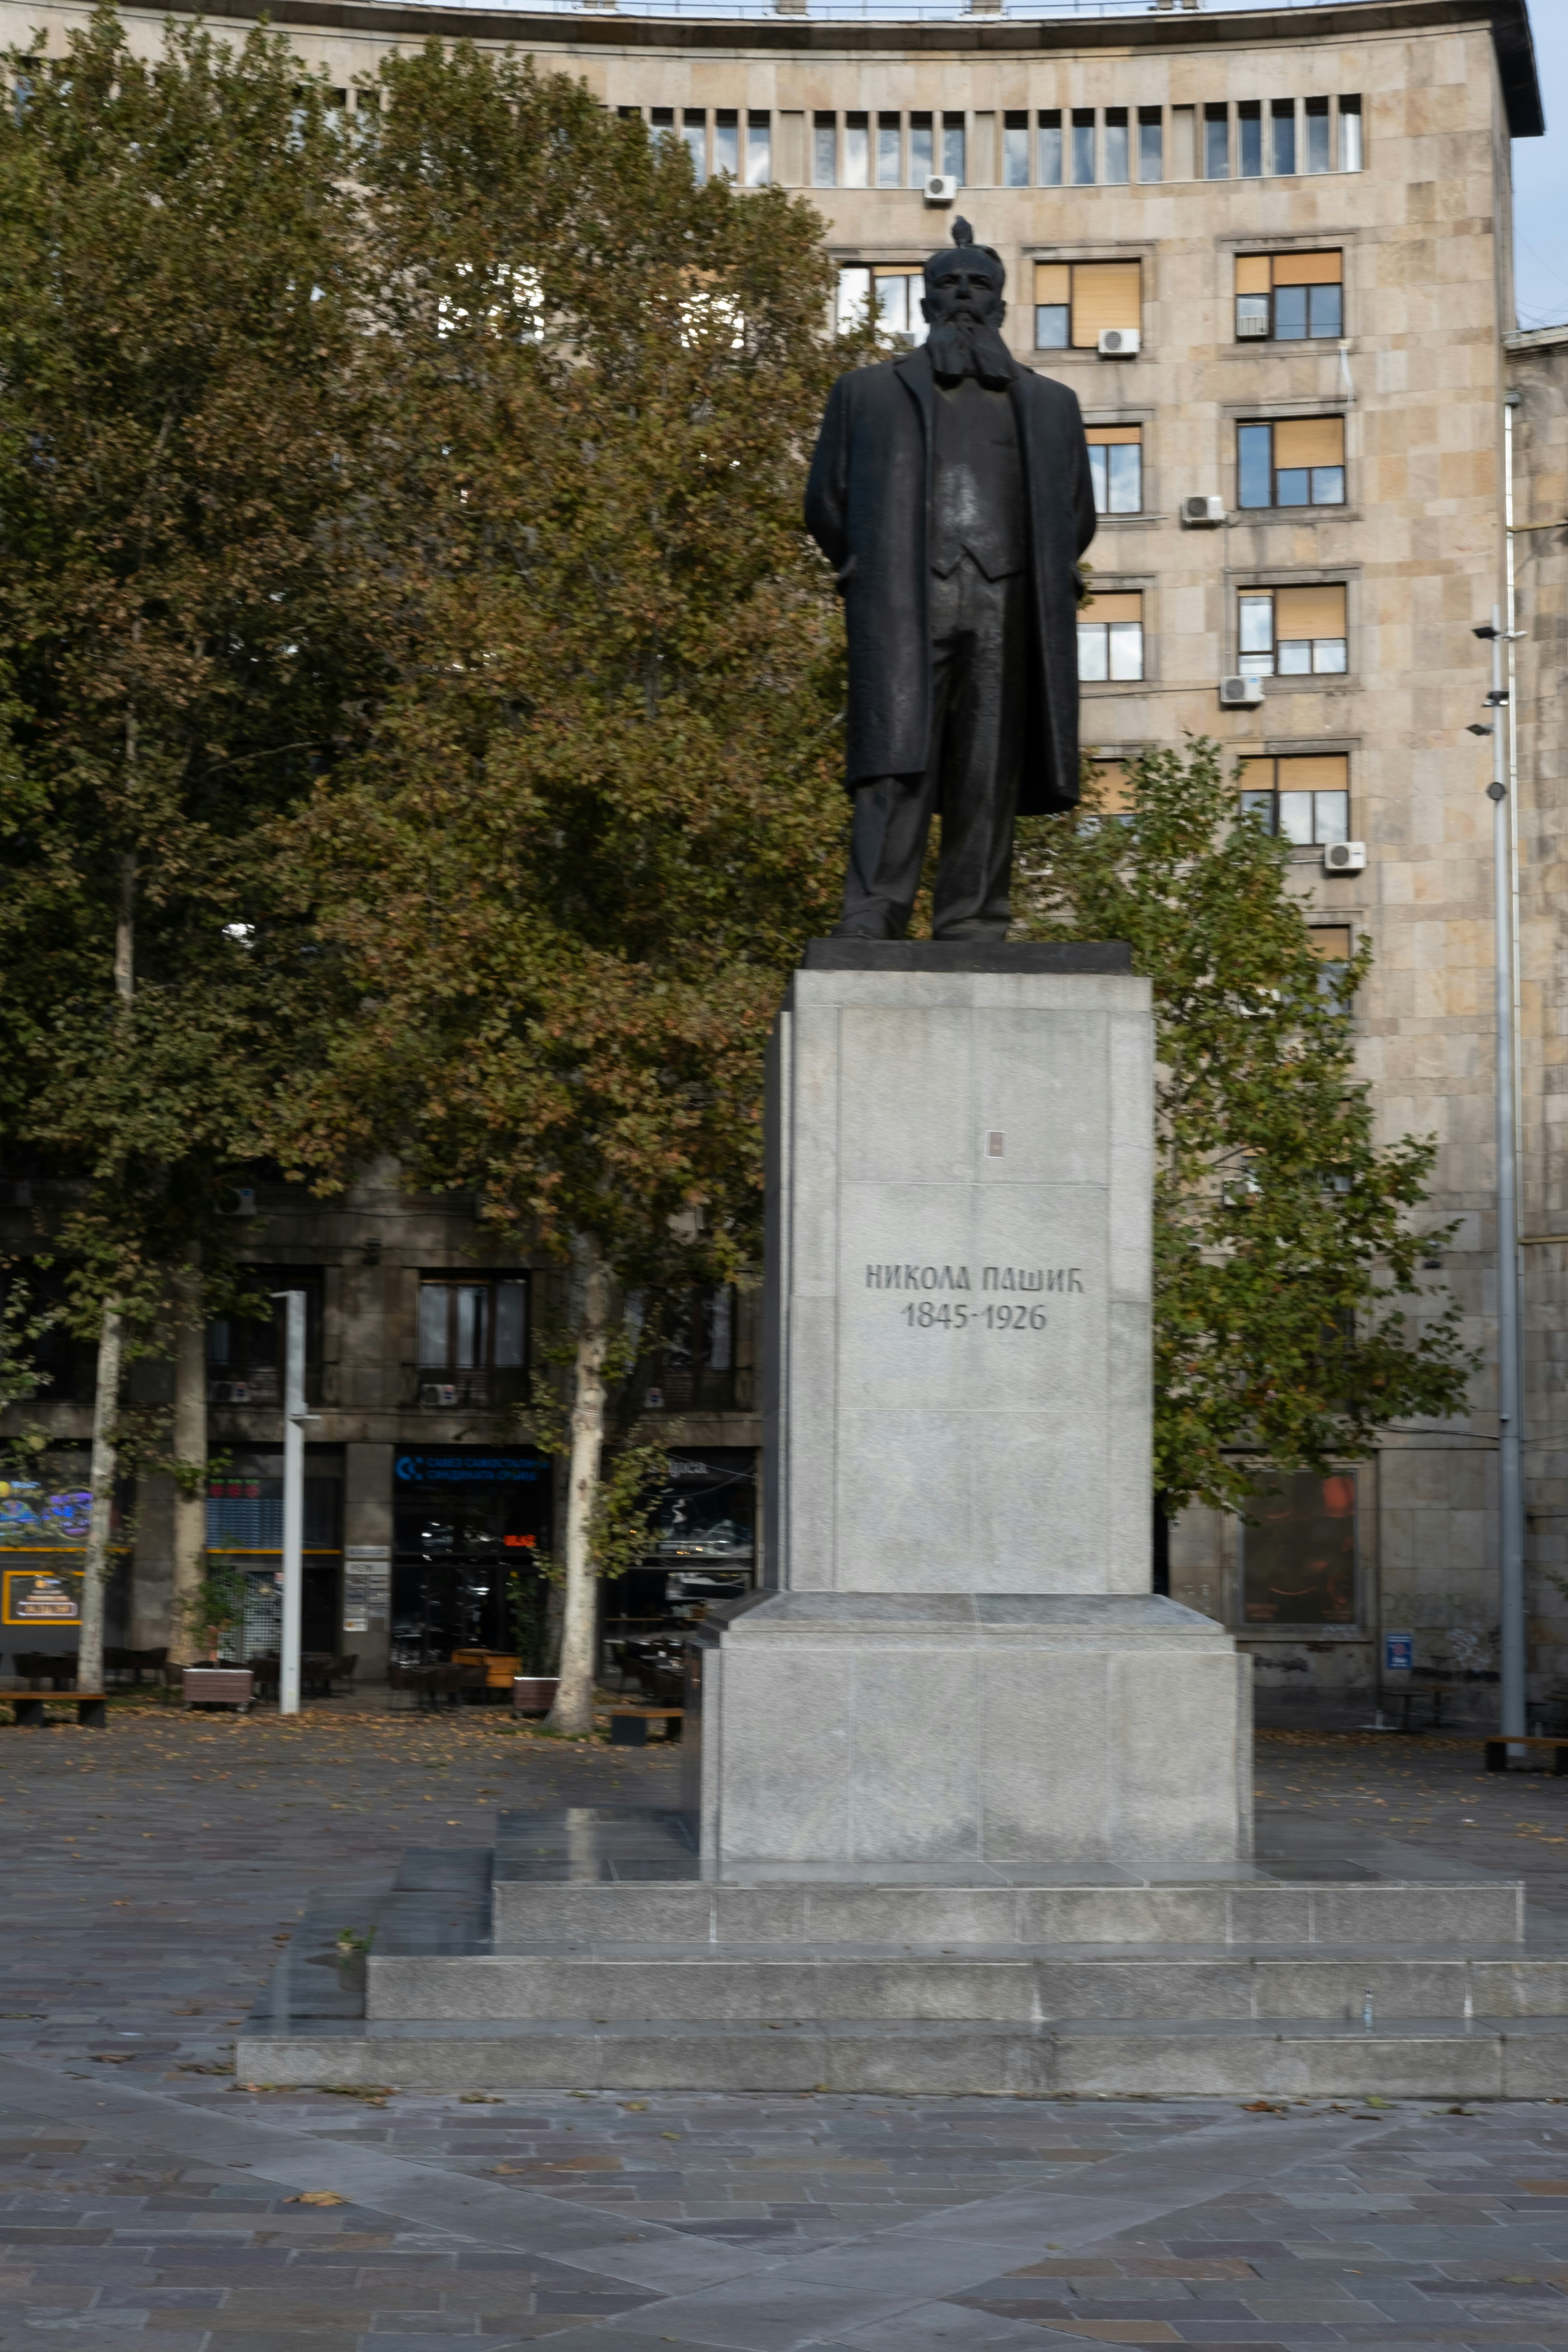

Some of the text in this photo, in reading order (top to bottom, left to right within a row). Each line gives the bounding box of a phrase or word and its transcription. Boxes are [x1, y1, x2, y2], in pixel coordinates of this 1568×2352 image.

[865, 1264, 1085, 1293] НИКОЛА ПАШИЋ
[900, 1301, 1047, 1329] 1845-1926
[464, 1458, 550, 1469] САМОСТАЛНХ
